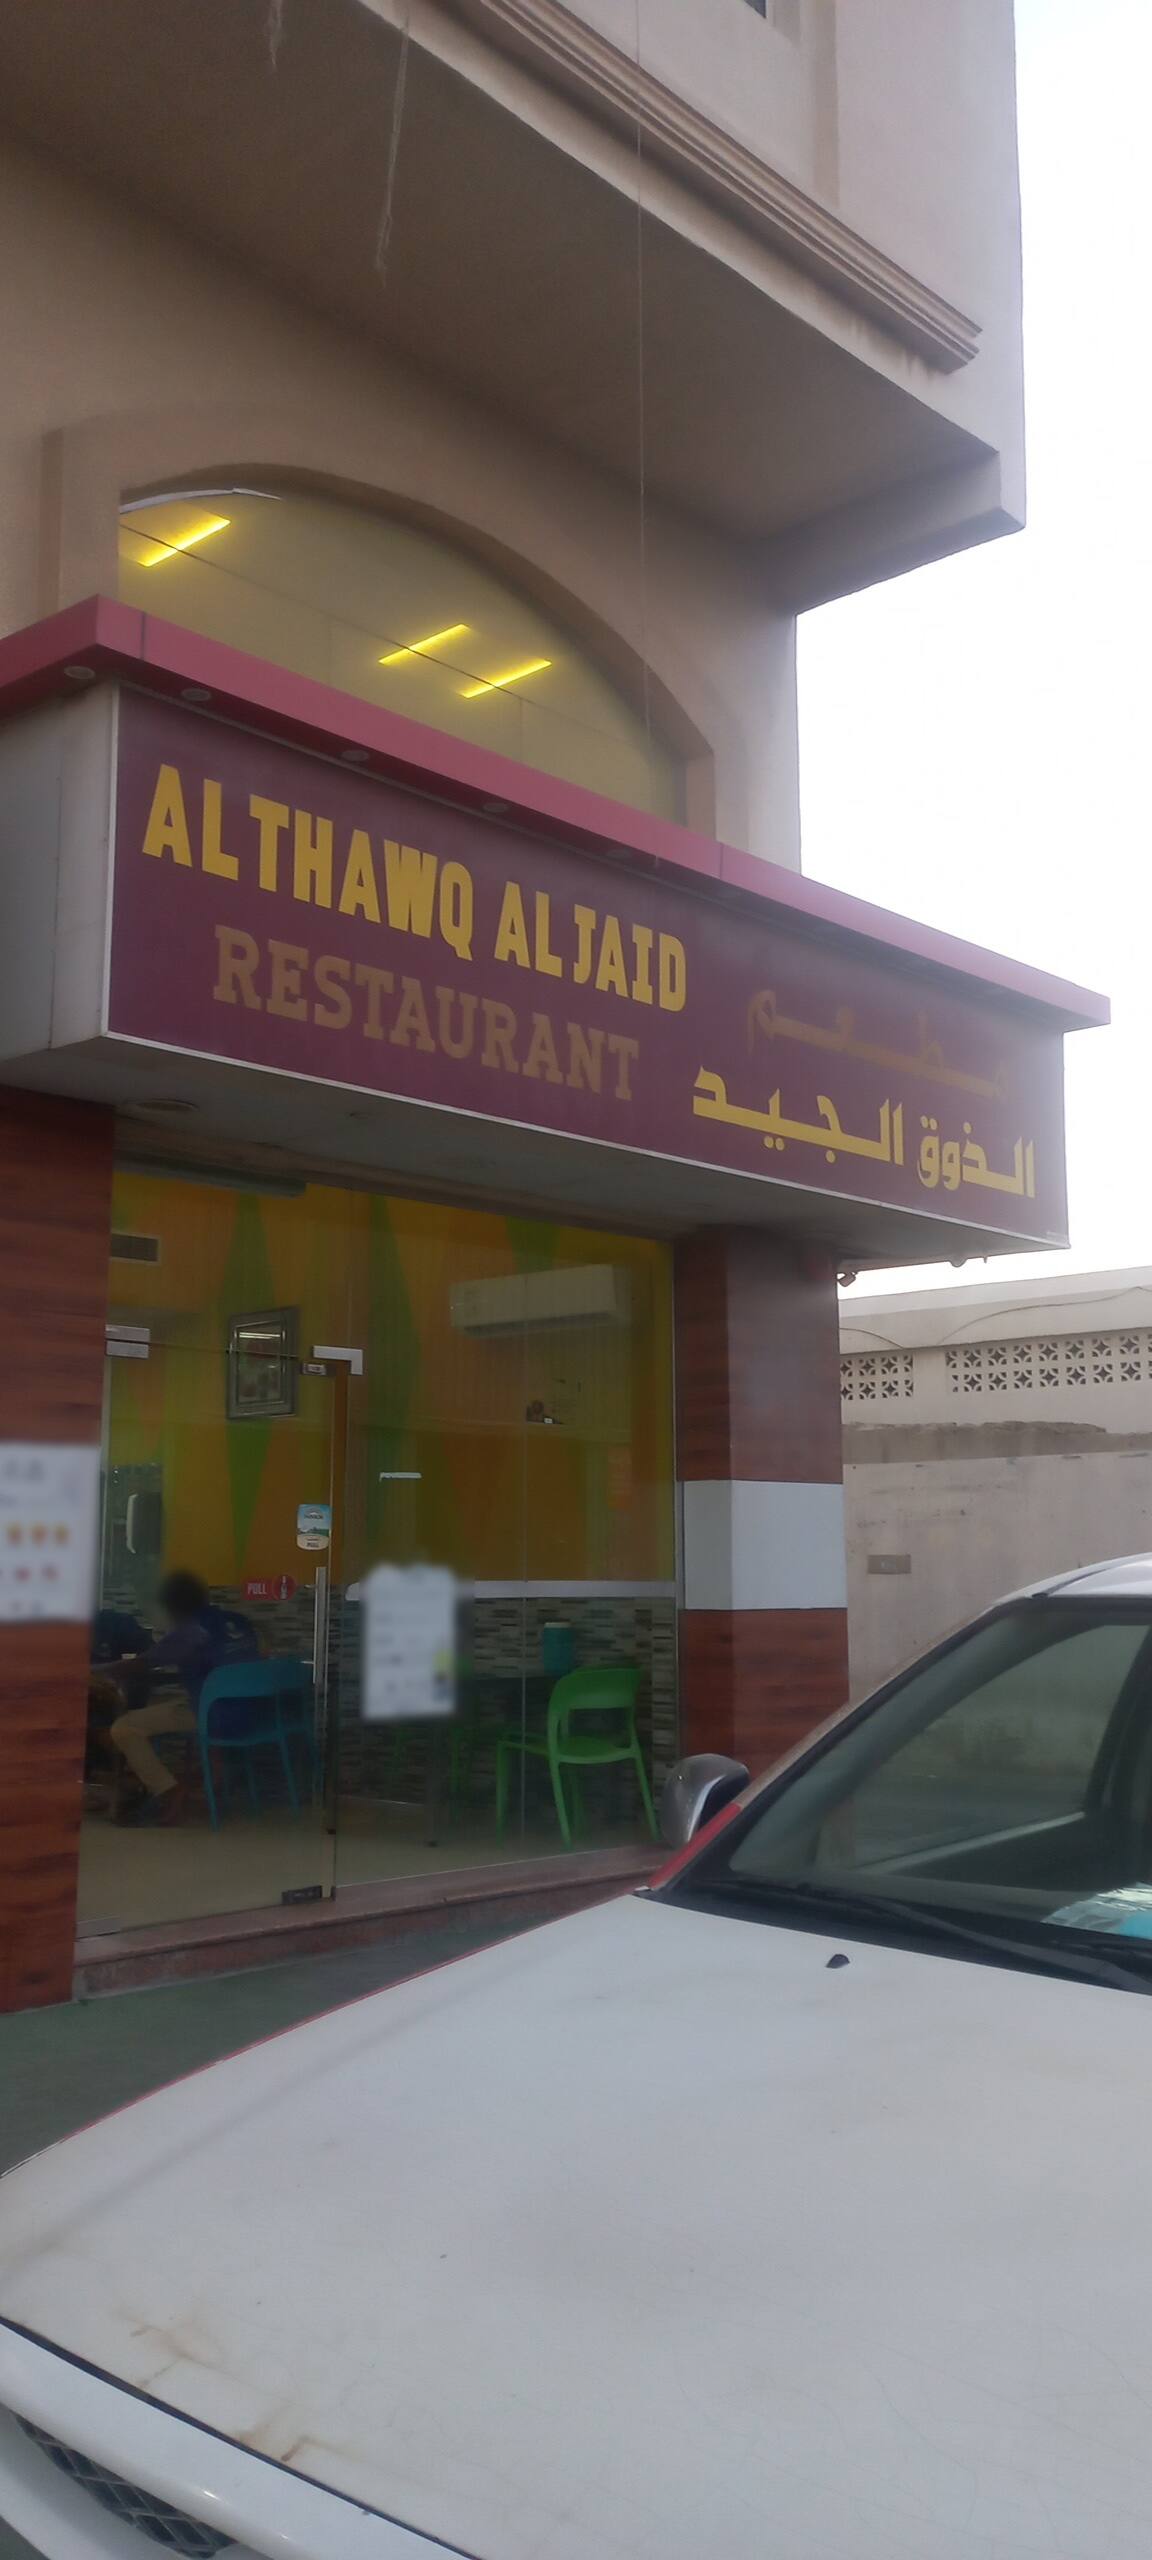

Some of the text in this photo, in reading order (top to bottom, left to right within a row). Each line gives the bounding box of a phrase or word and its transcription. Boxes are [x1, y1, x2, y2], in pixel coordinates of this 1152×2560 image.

[212, 924, 640, 1101] RESTAURANT
[692, 1065, 1036, 1198] الذوق الجيد
[247, 1582, 267, 1595] PULL
